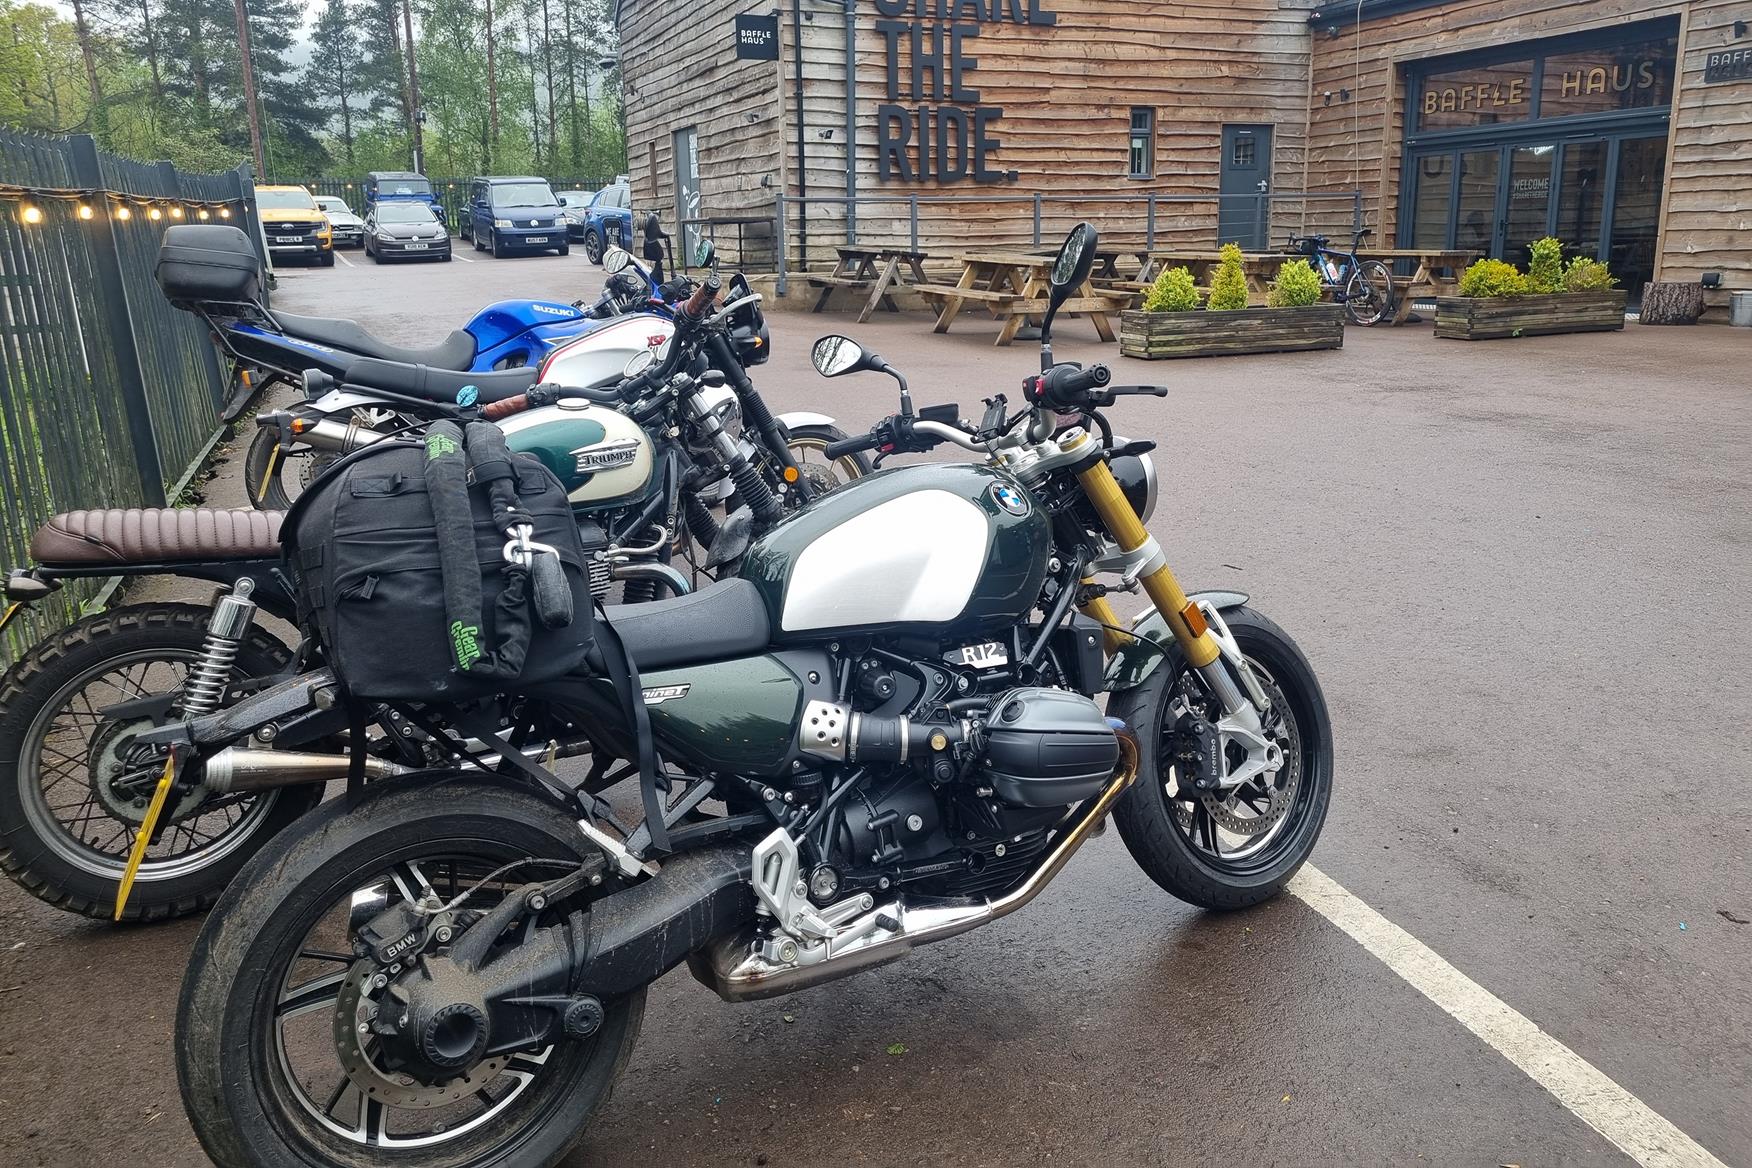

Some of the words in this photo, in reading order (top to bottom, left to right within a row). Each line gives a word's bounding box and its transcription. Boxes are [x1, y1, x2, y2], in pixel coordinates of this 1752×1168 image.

[741, 29, 771, 39] BAFFLE
[741, 36, 764, 45] HAUS
[876, 20, 980, 102] THE
[1424, 78, 1525, 115] BAFFLE
[1561, 61, 1655, 98] HAUS
[878, 104, 1019, 182] RIDE.
[1514, 178, 1549, 190] WELCOME
[532, 304, 575, 317] SUZUKI
[584, 450, 633, 465] TRIUMPH
[1210, 738, 1218, 776] brembo
[387, 933, 416, 957] BMW
